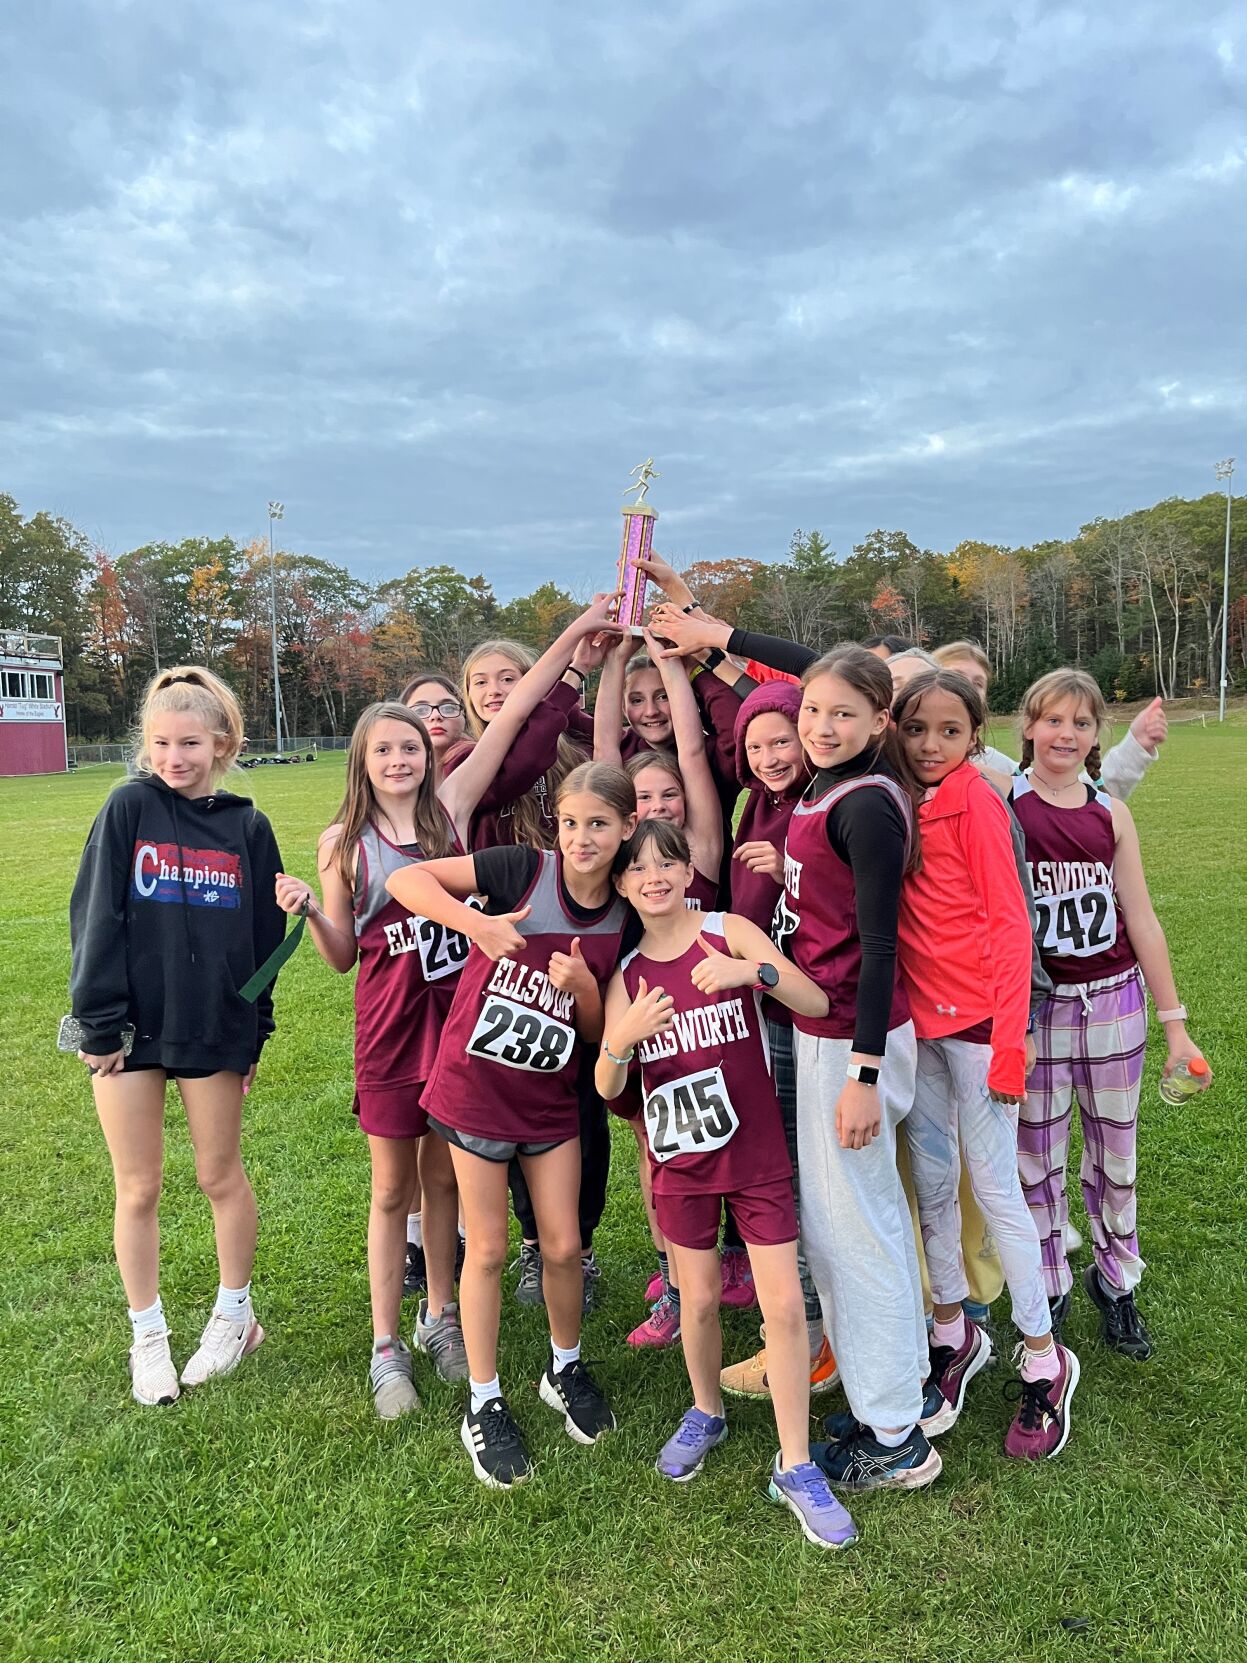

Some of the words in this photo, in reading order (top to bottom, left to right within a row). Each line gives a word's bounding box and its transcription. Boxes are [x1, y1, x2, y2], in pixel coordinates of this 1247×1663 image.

[135, 845, 236, 897] Champions
[420, 901, 481, 973] 25
[1033, 891, 1111, 955] 242
[471, 1004, 569, 1070] 238
[647, 1075, 733, 1154] 245
